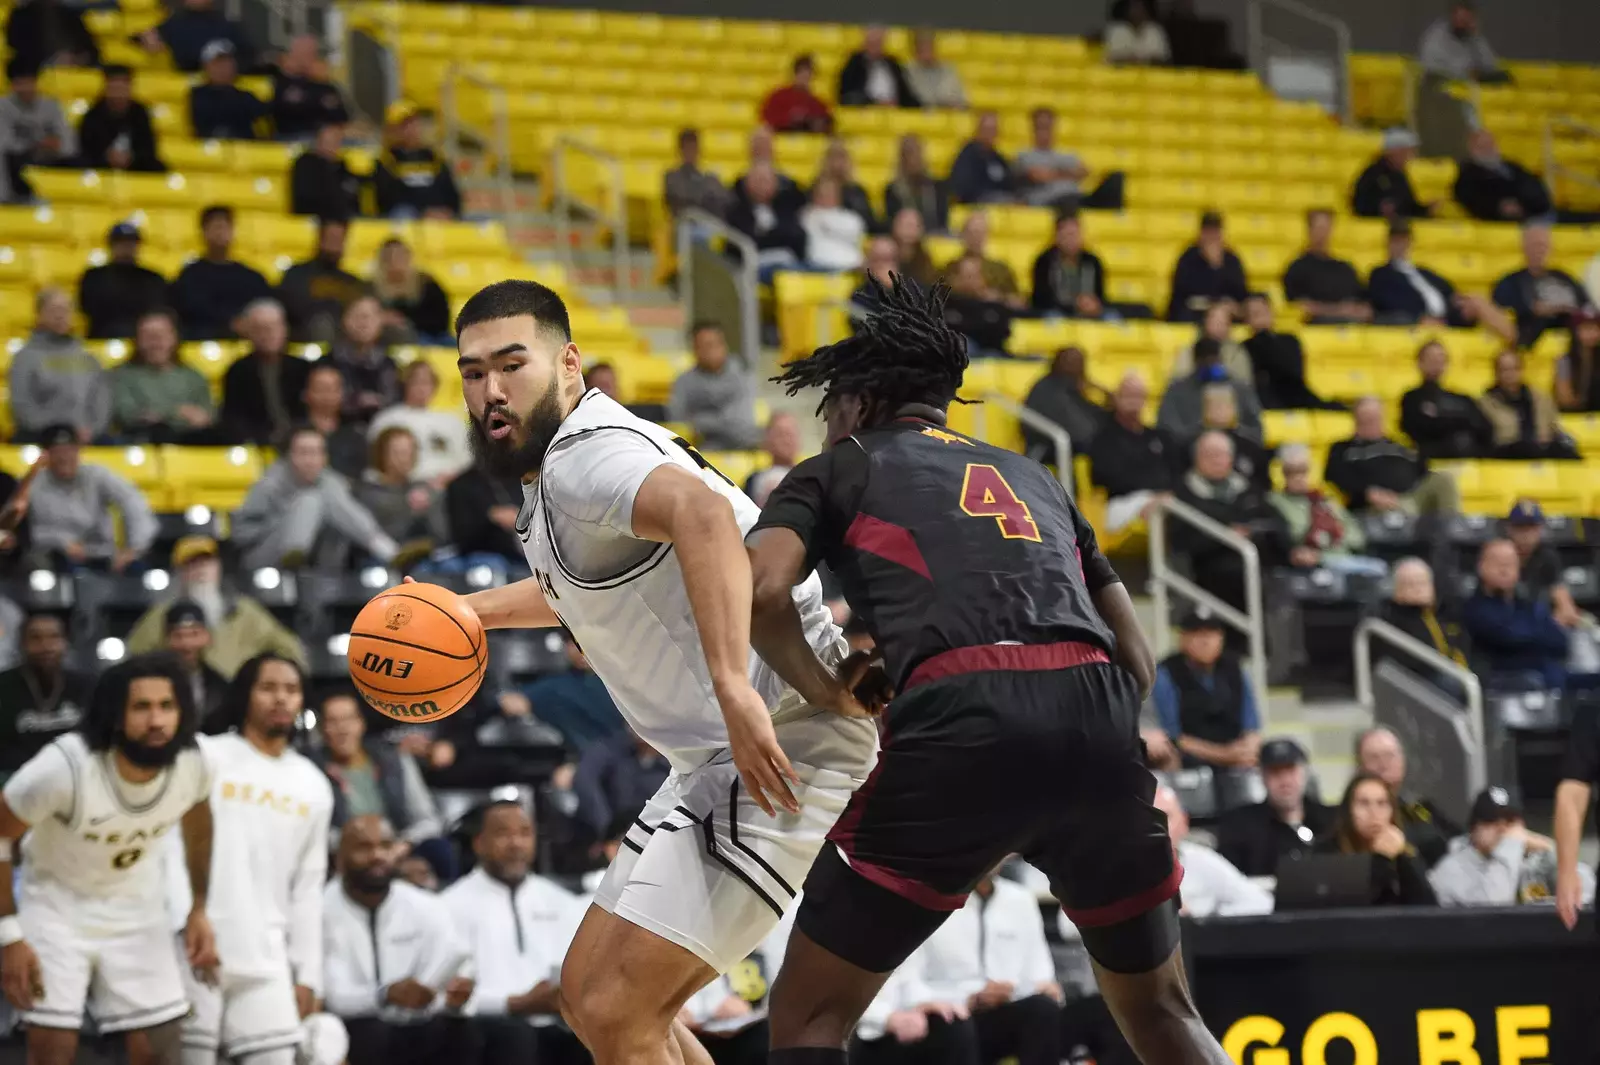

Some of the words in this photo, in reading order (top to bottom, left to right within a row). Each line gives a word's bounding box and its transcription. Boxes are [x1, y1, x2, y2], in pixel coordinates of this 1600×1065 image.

[959, 463, 1042, 542] 4
[361, 652, 414, 679] EVO
[221, 781, 310, 817] BEACH
[1221, 1011, 1379, 1065] GO
